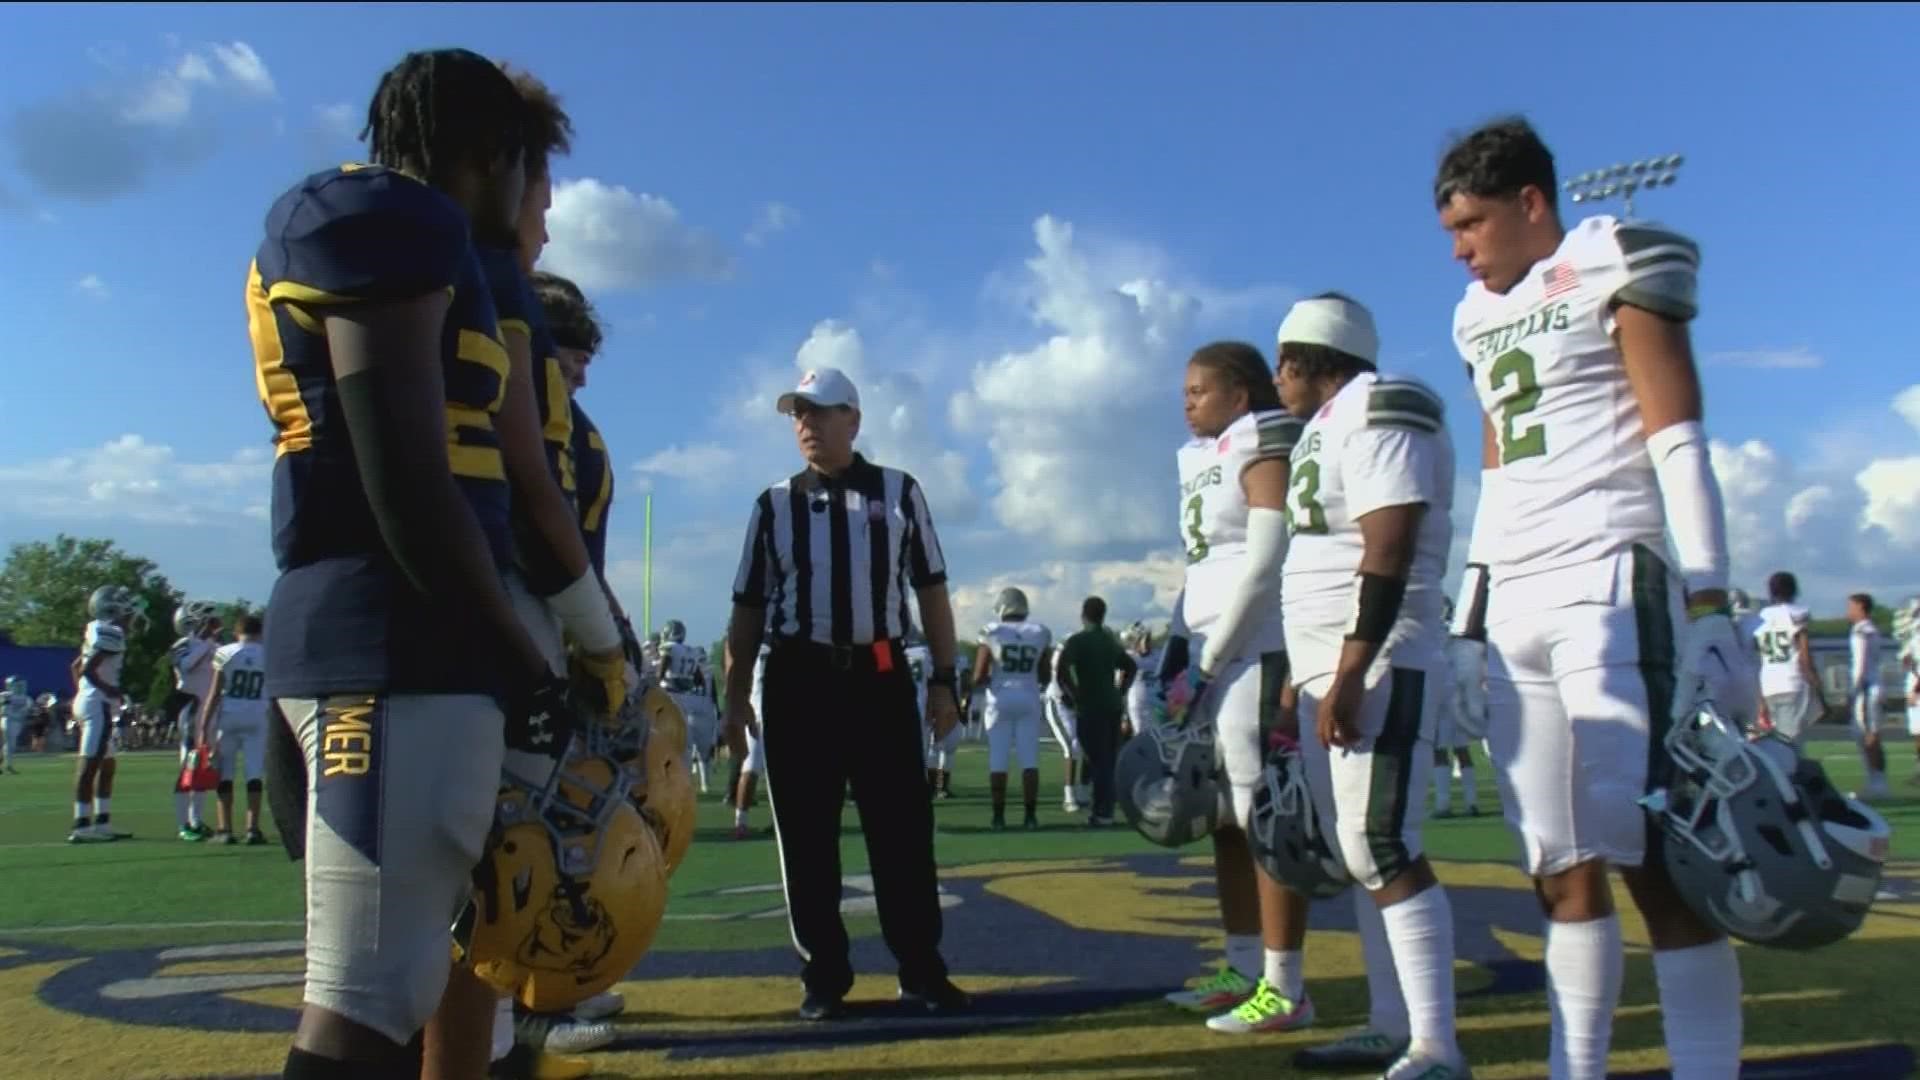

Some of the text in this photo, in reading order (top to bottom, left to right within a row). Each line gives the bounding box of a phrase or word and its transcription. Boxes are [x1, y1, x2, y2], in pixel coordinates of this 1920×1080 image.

[1490, 347, 1547, 465] 2
[231, 669, 265, 700] 80
[1001, 644, 1038, 674] 56
[324, 696, 375, 777] MER
